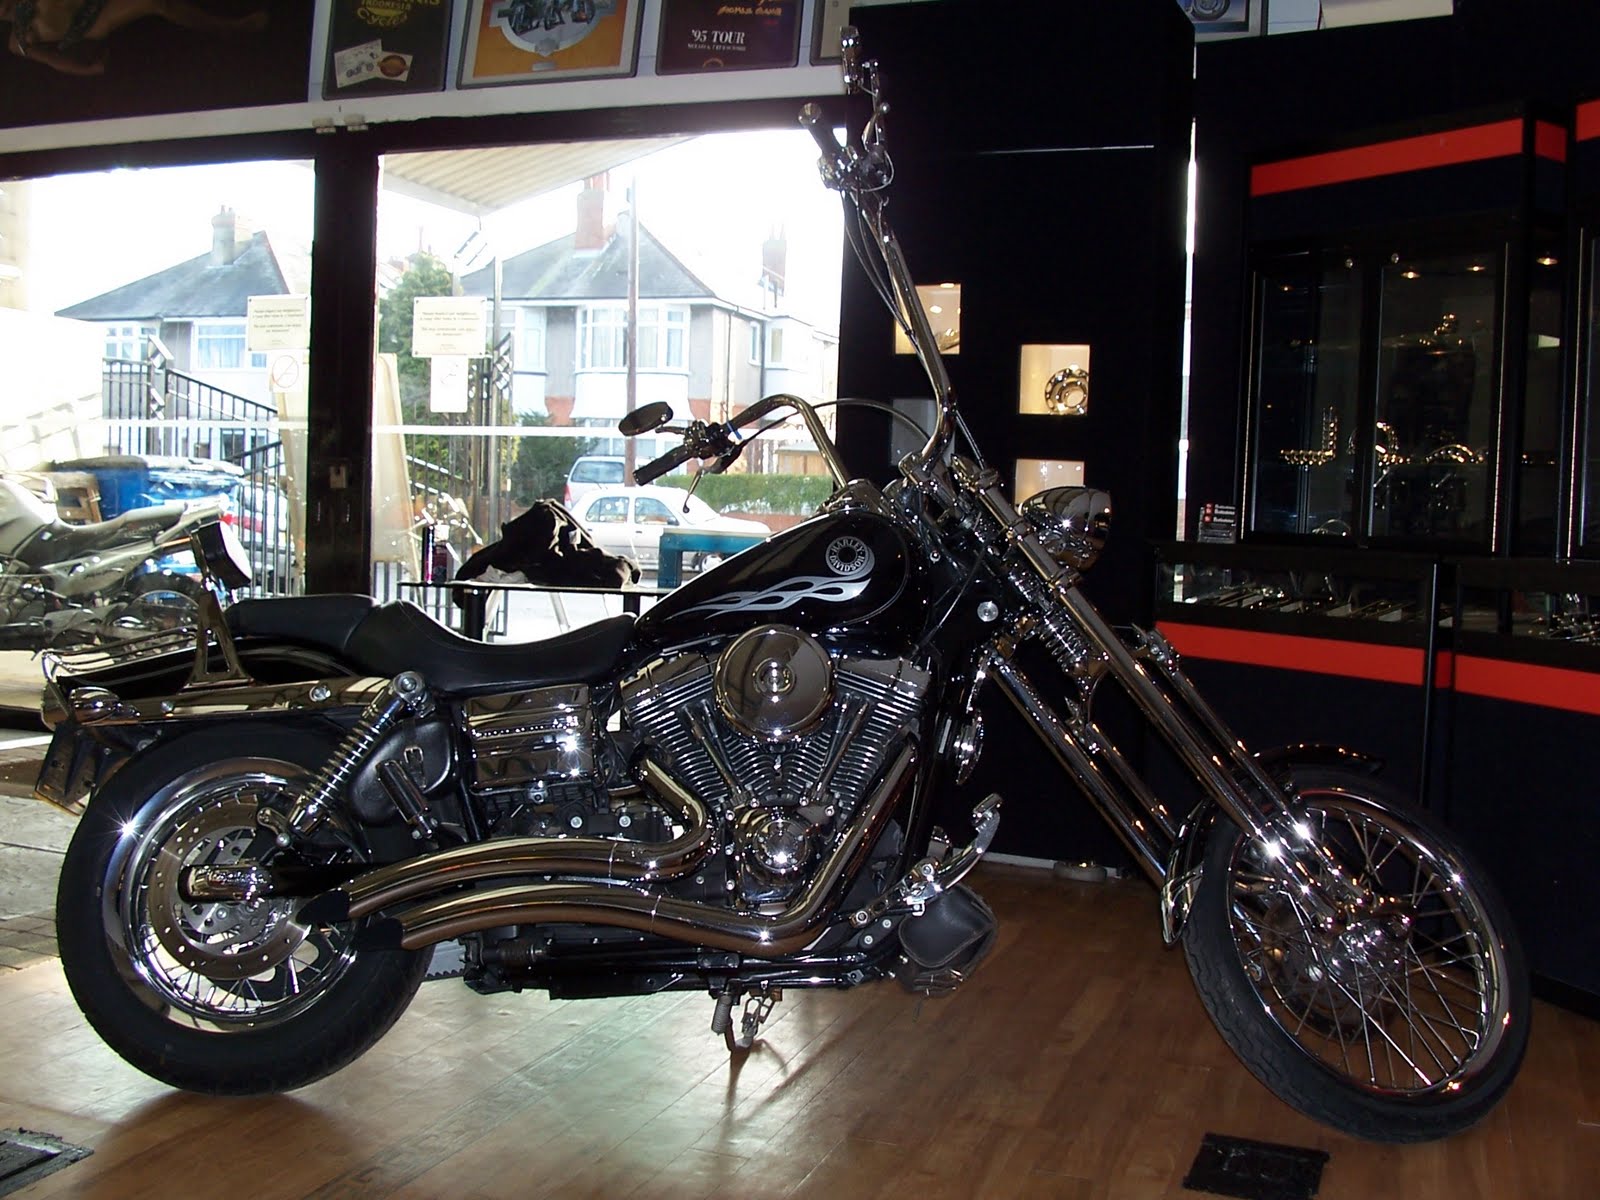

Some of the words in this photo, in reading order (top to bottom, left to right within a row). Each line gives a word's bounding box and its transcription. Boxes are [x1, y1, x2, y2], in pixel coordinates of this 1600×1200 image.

[691, 29, 708, 43] '95
[711, 30, 746, 45] TOUR
[830, 539, 865, 553] HARLEY
[829, 555, 865, 572] DAVIDSON
